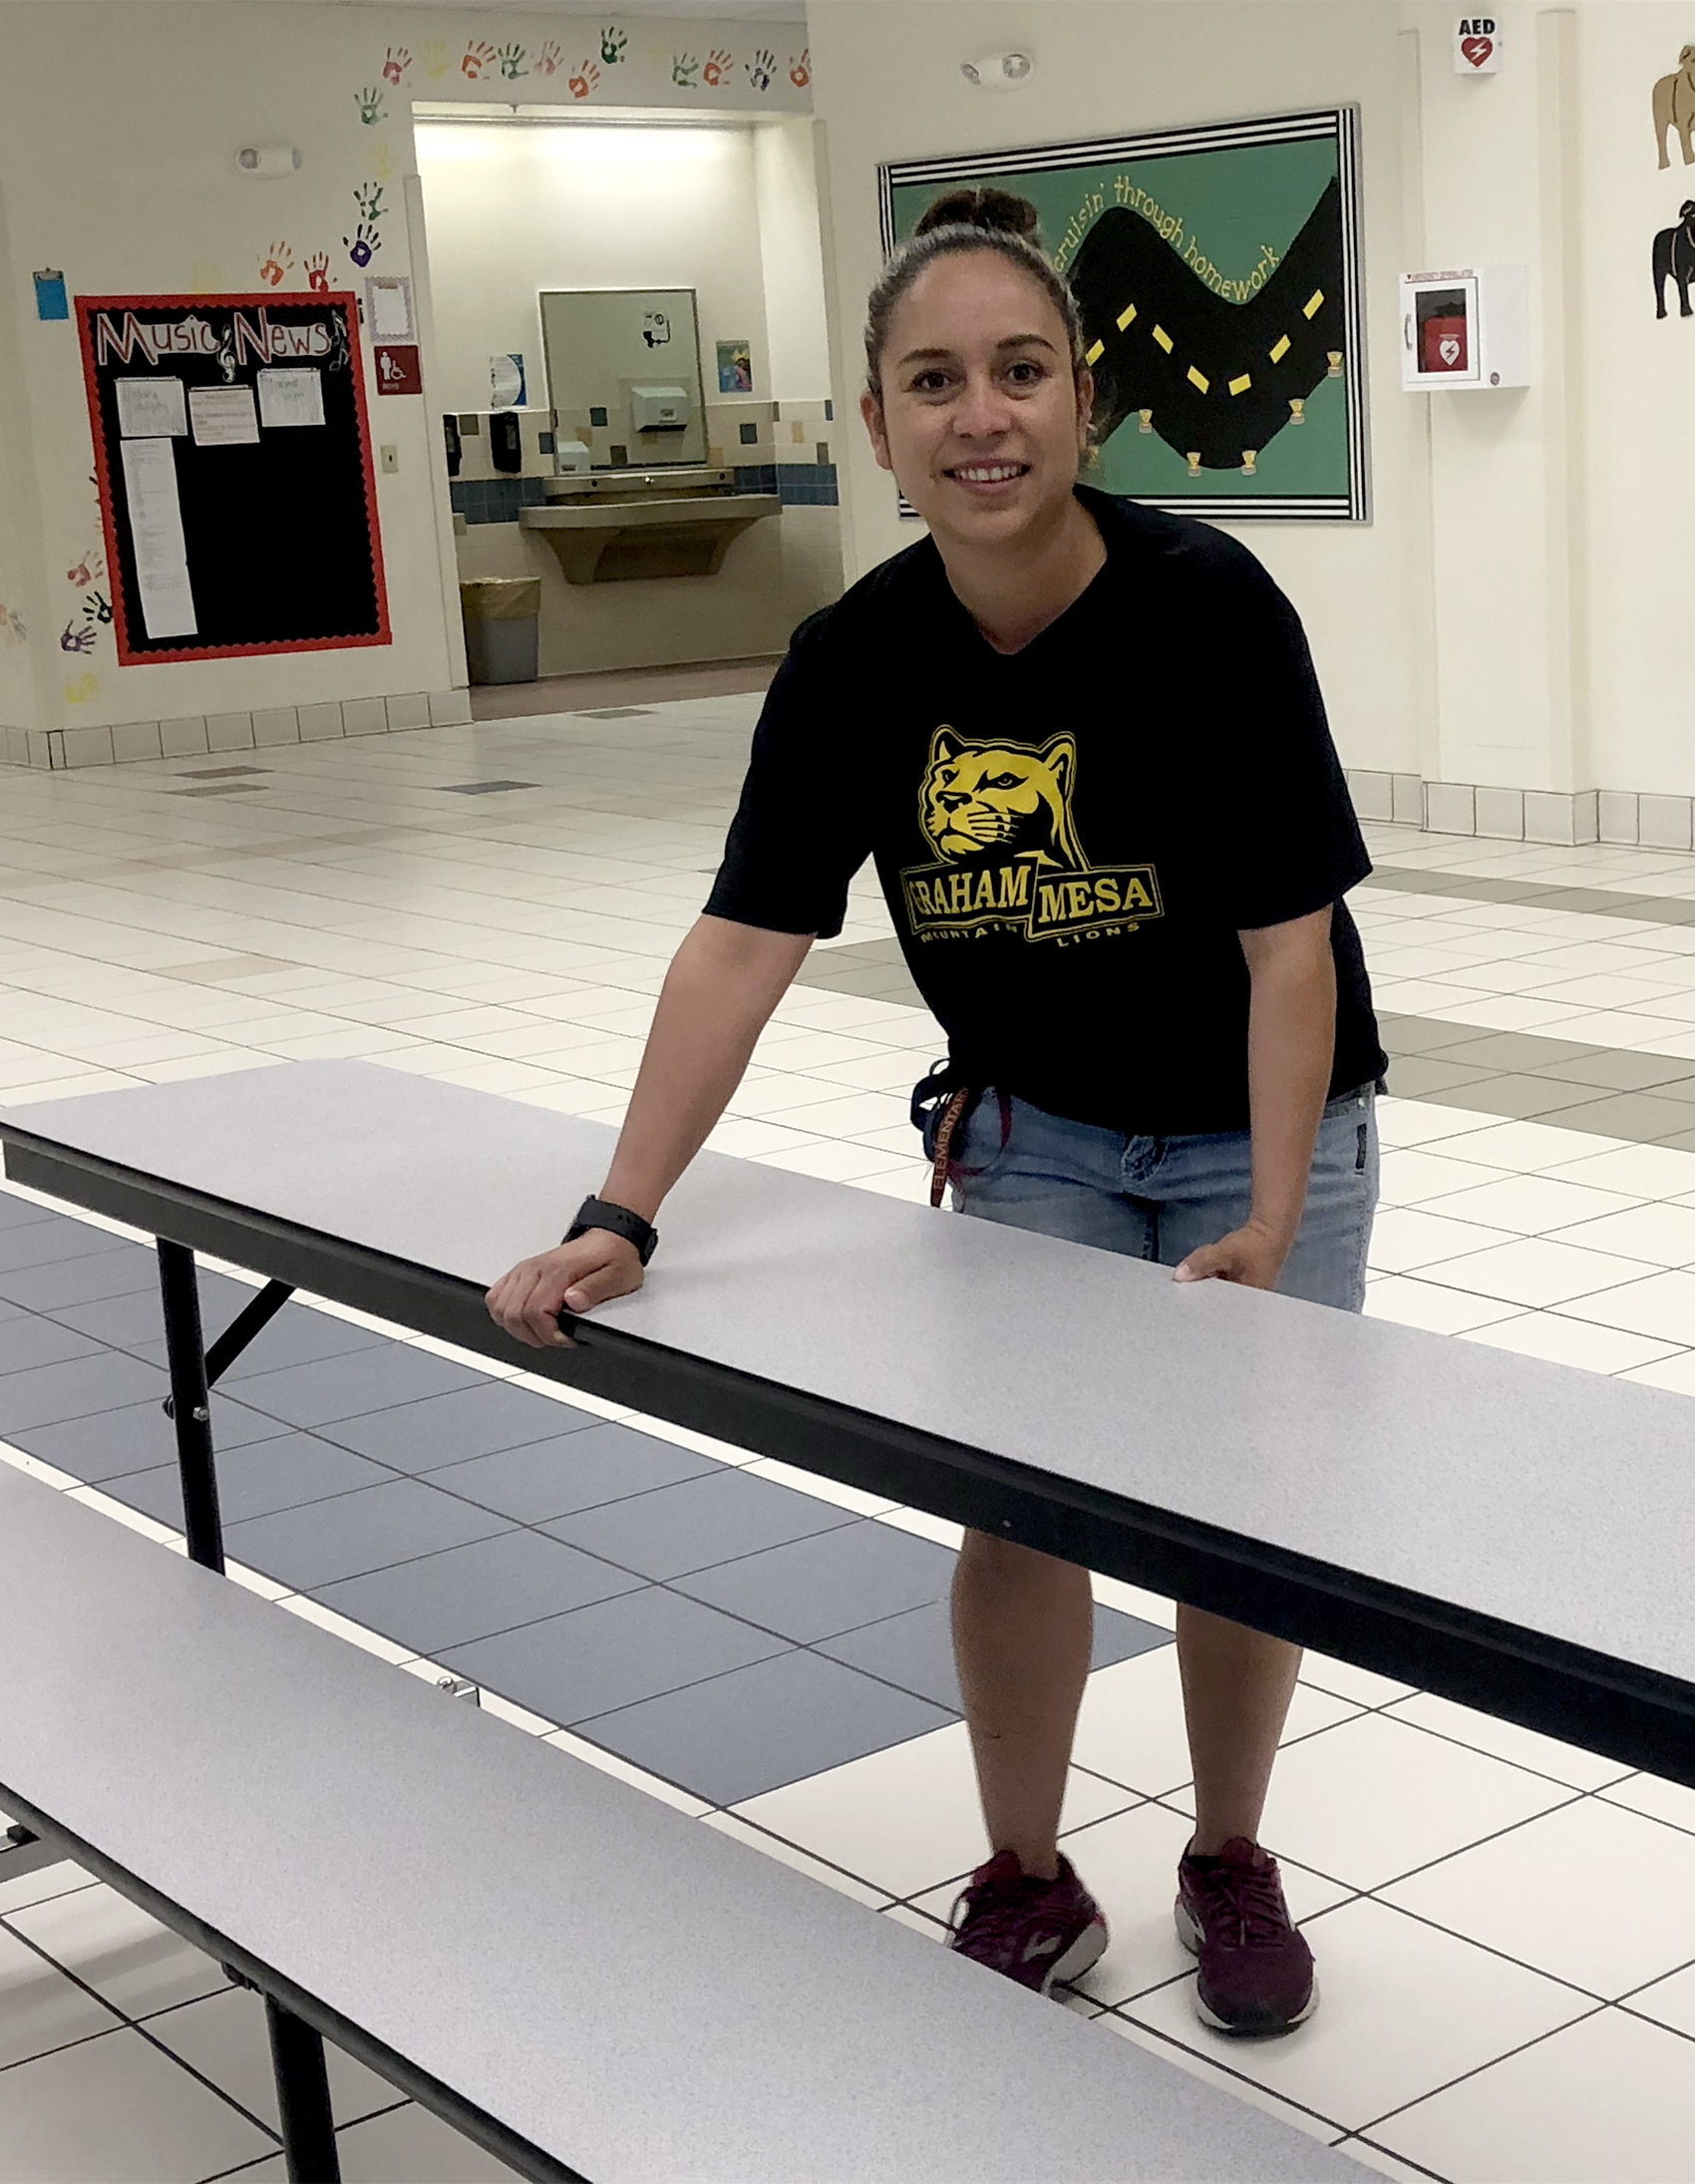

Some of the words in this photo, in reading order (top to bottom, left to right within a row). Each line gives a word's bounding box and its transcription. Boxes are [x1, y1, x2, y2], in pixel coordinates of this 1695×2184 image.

[1459, 19, 1496, 36] AED
[1114, 175, 1185, 248] through
[1184, 235, 1280, 301] homework
[97, 312, 220, 366] Music
[234, 307, 332, 365] News
[1038, 878, 1154, 923] MESA
[1057, 920, 1141, 947] LIONS
